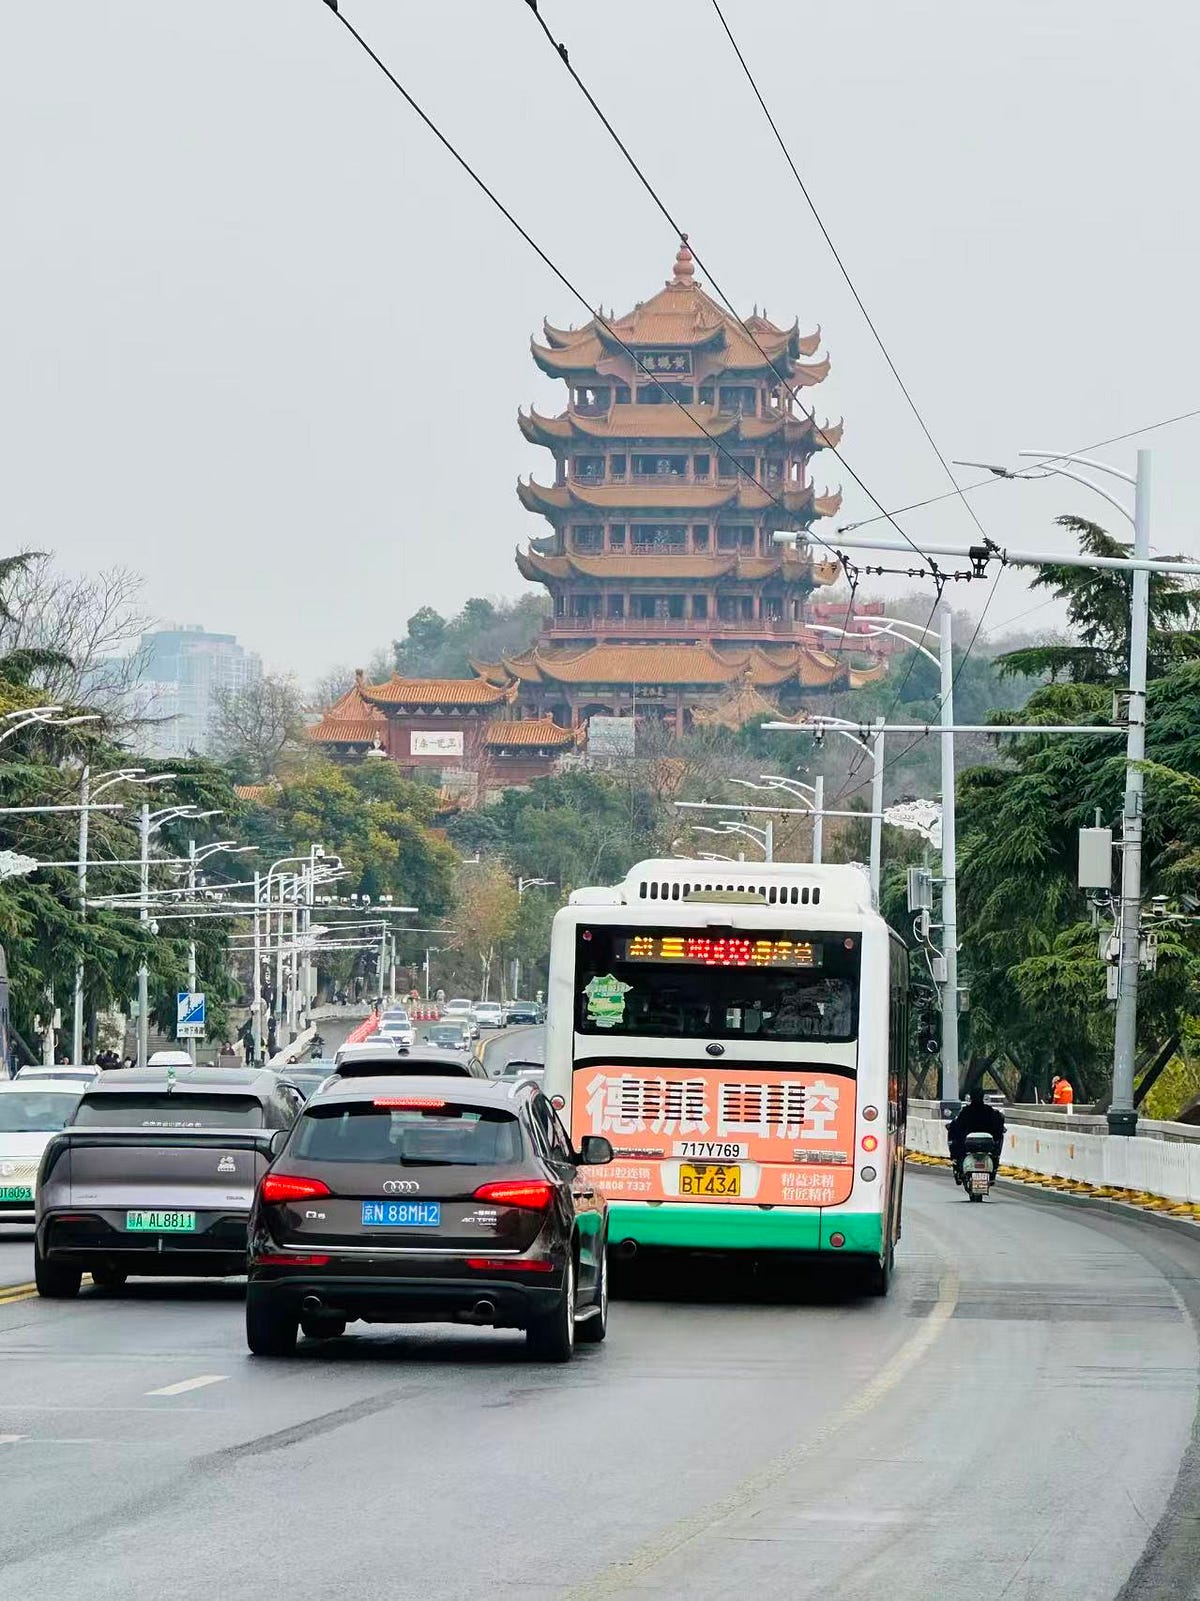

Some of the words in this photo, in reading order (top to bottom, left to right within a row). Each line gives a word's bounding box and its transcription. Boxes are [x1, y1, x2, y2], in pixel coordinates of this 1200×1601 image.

[585, 1073, 840, 1140] 德派口腔
[681, 1142, 740, 1157] 717Y769
[682, 1176, 738, 1194] BT434
[149, 1213, 192, 1228] AL8811
[364, 1204, 384, 1222] 京N
[389, 1205, 438, 1223] 88MH2
